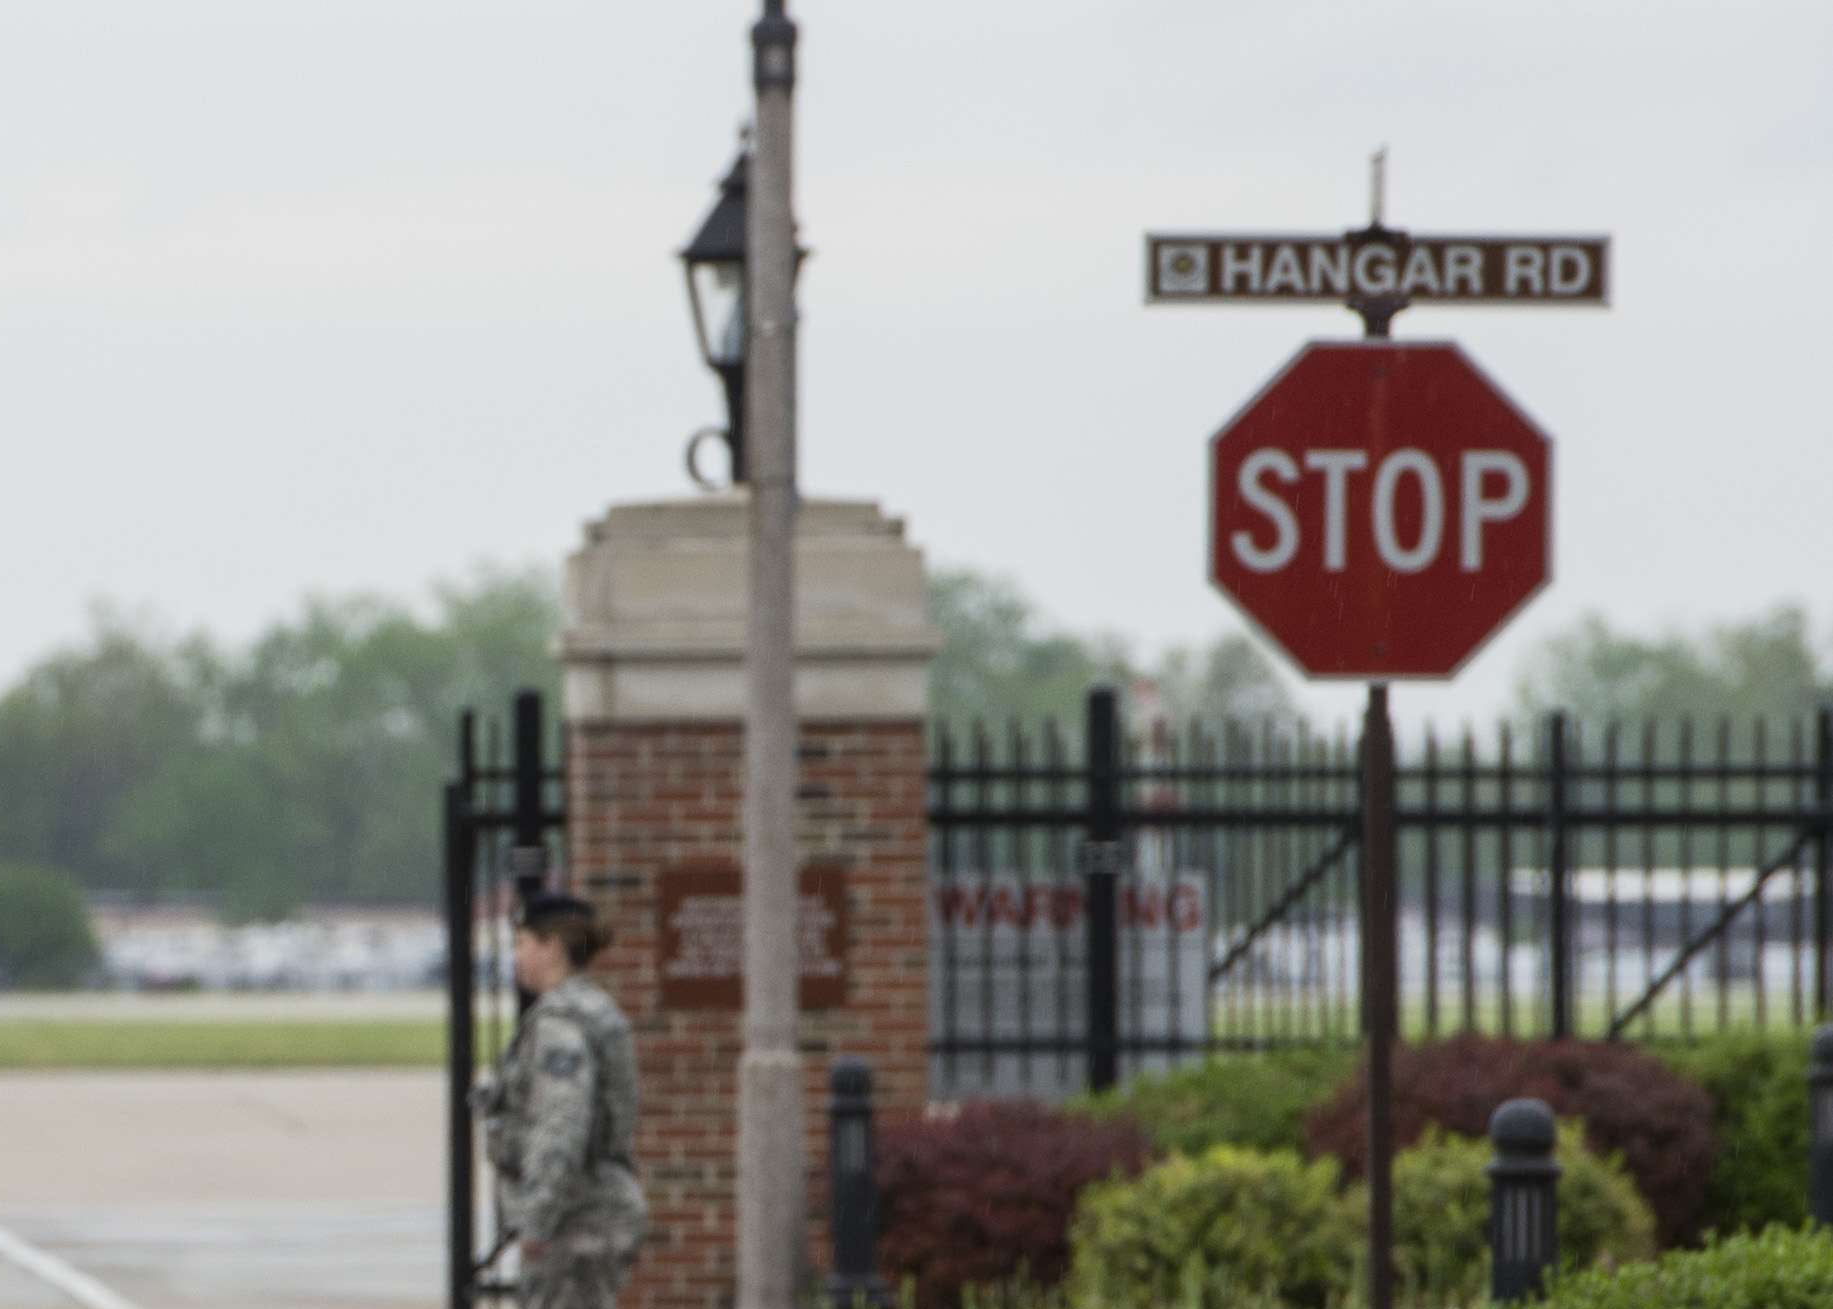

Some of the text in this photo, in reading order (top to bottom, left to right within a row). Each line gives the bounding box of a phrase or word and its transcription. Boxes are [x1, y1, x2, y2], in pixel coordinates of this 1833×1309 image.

[1221, 243, 1592, 295] HANGAR RD
[1230, 447, 1531, 575] STOP
[934, 882, 1204, 932] WARNNG
